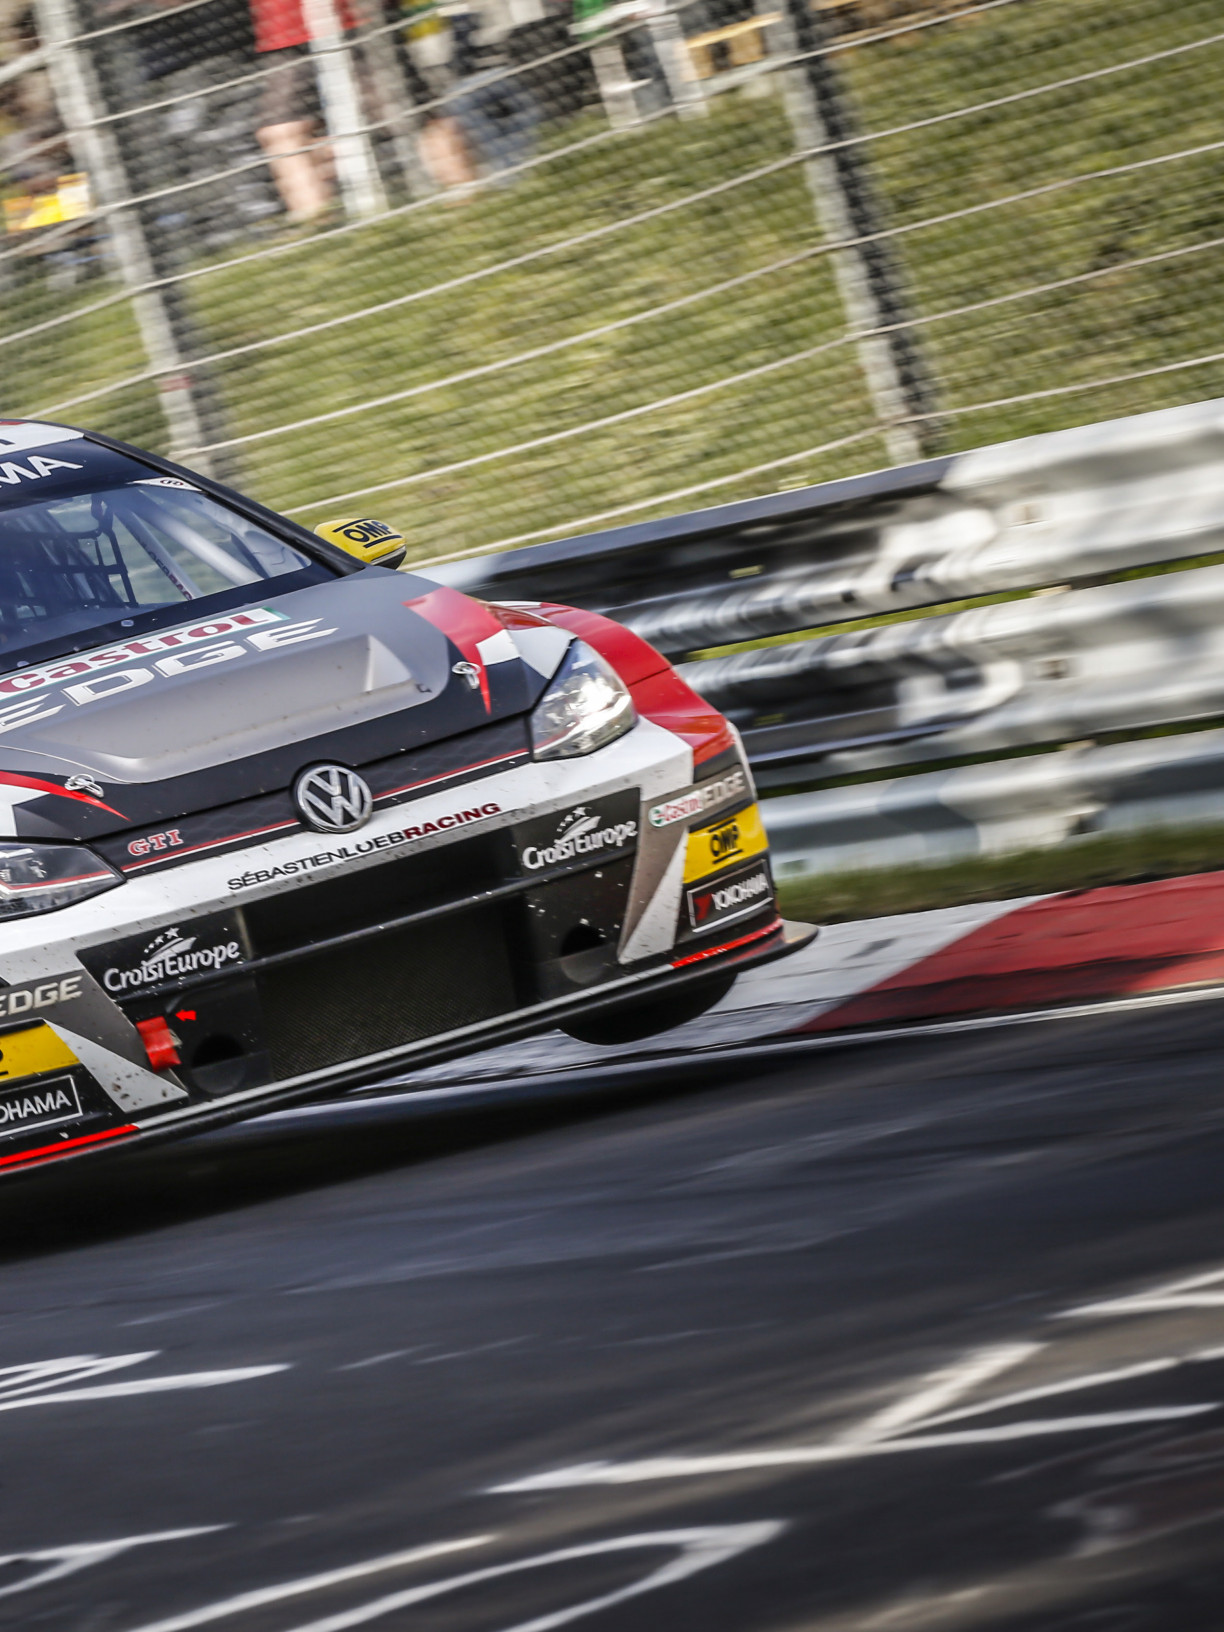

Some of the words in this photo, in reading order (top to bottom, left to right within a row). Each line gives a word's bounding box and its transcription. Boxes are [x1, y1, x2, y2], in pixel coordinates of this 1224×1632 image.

[343, 519, 394, 543] OMP
[127, 829, 183, 857] GTI
[103, 938, 240, 992] CroisiEurope
